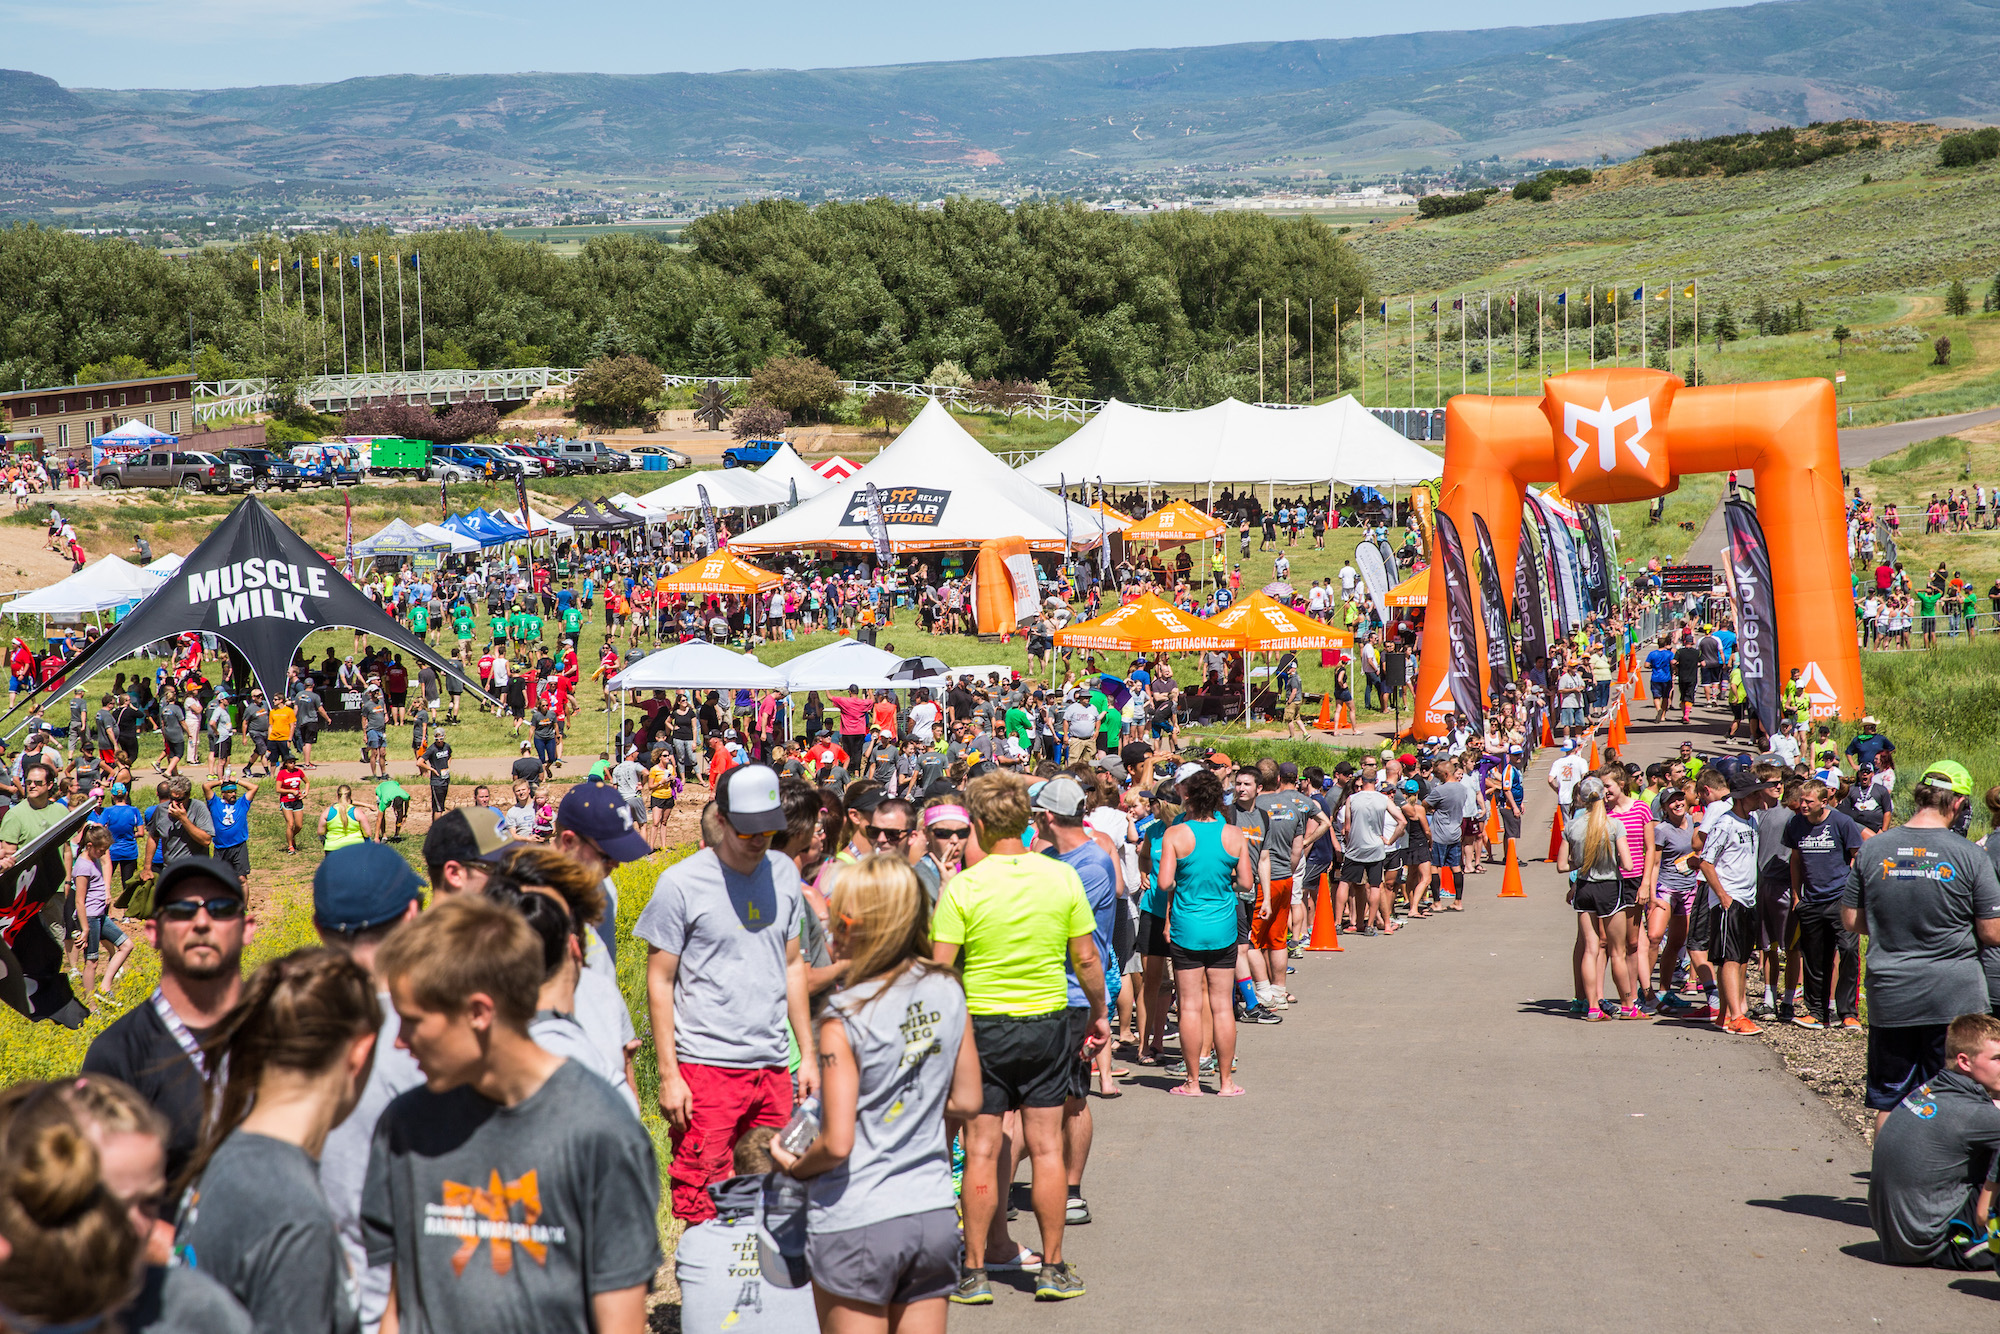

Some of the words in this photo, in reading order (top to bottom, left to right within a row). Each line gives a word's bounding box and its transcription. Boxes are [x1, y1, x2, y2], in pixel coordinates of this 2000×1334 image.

[917, 494, 945, 503] RELAY
[882, 503, 939, 514] GEAR
[883, 513, 936, 523] STORE
[187, 557, 330, 605] MUSCLE
